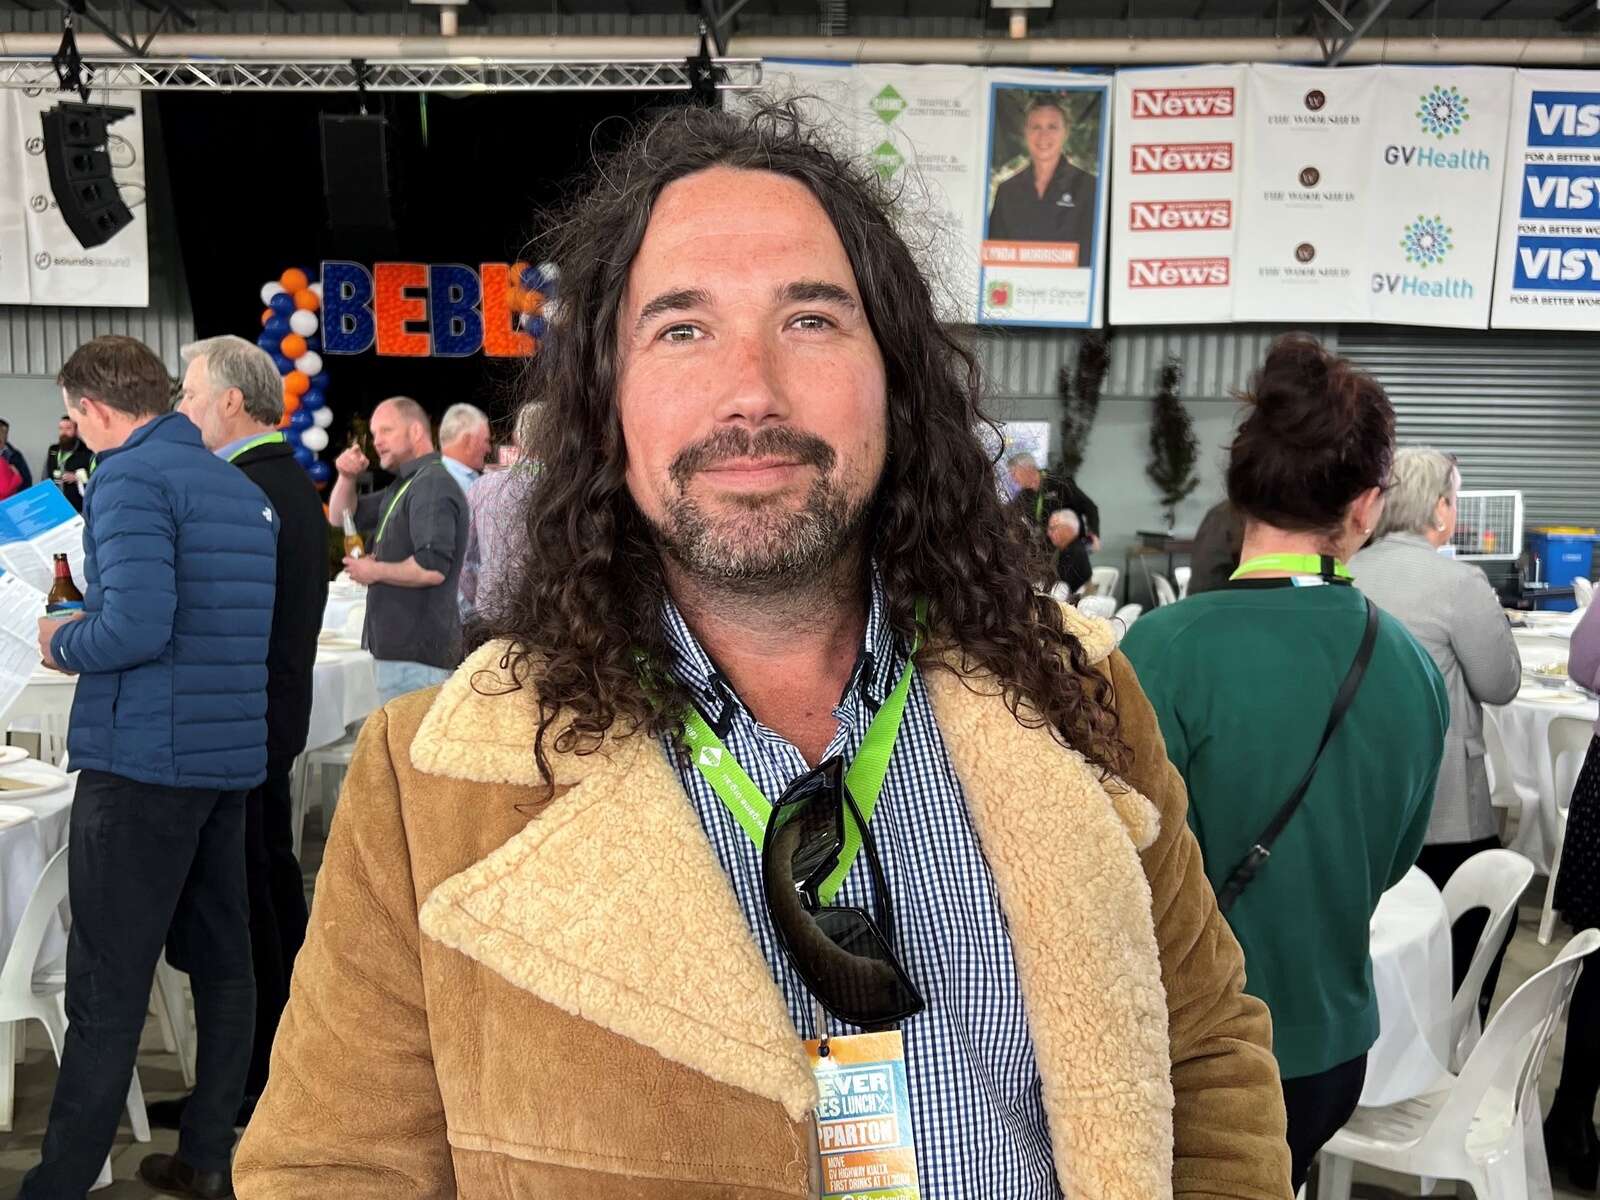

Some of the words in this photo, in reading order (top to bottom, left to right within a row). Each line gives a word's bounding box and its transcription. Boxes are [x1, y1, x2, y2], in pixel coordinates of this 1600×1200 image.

[1135, 91, 1233, 116] News
[1134, 146, 1231, 171] News
[1525, 152, 1545, 161] FOR
[1547, 152, 1554, 161] A
[1556, 152, 1591, 162] BETTER
[1133, 204, 1230, 229] News
[1518, 224, 1537, 233] FOR
[1539, 224, 1546, 233] A
[1548, 224, 1583, 234] BETTER
[1131, 261, 1228, 286] News
[1510, 295, 1529, 304] FOR
[1532, 295, 1538, 304] A
[1541, 296, 1575, 305] BETTER
[817, 1071, 889, 1098] EVER
[842, 1093, 876, 1115] LUNCH
[830, 1179, 848, 1192] FIRST
[873, 1175, 881, 1187] AT
[838, 1166, 865, 1179] HIGHWAY
